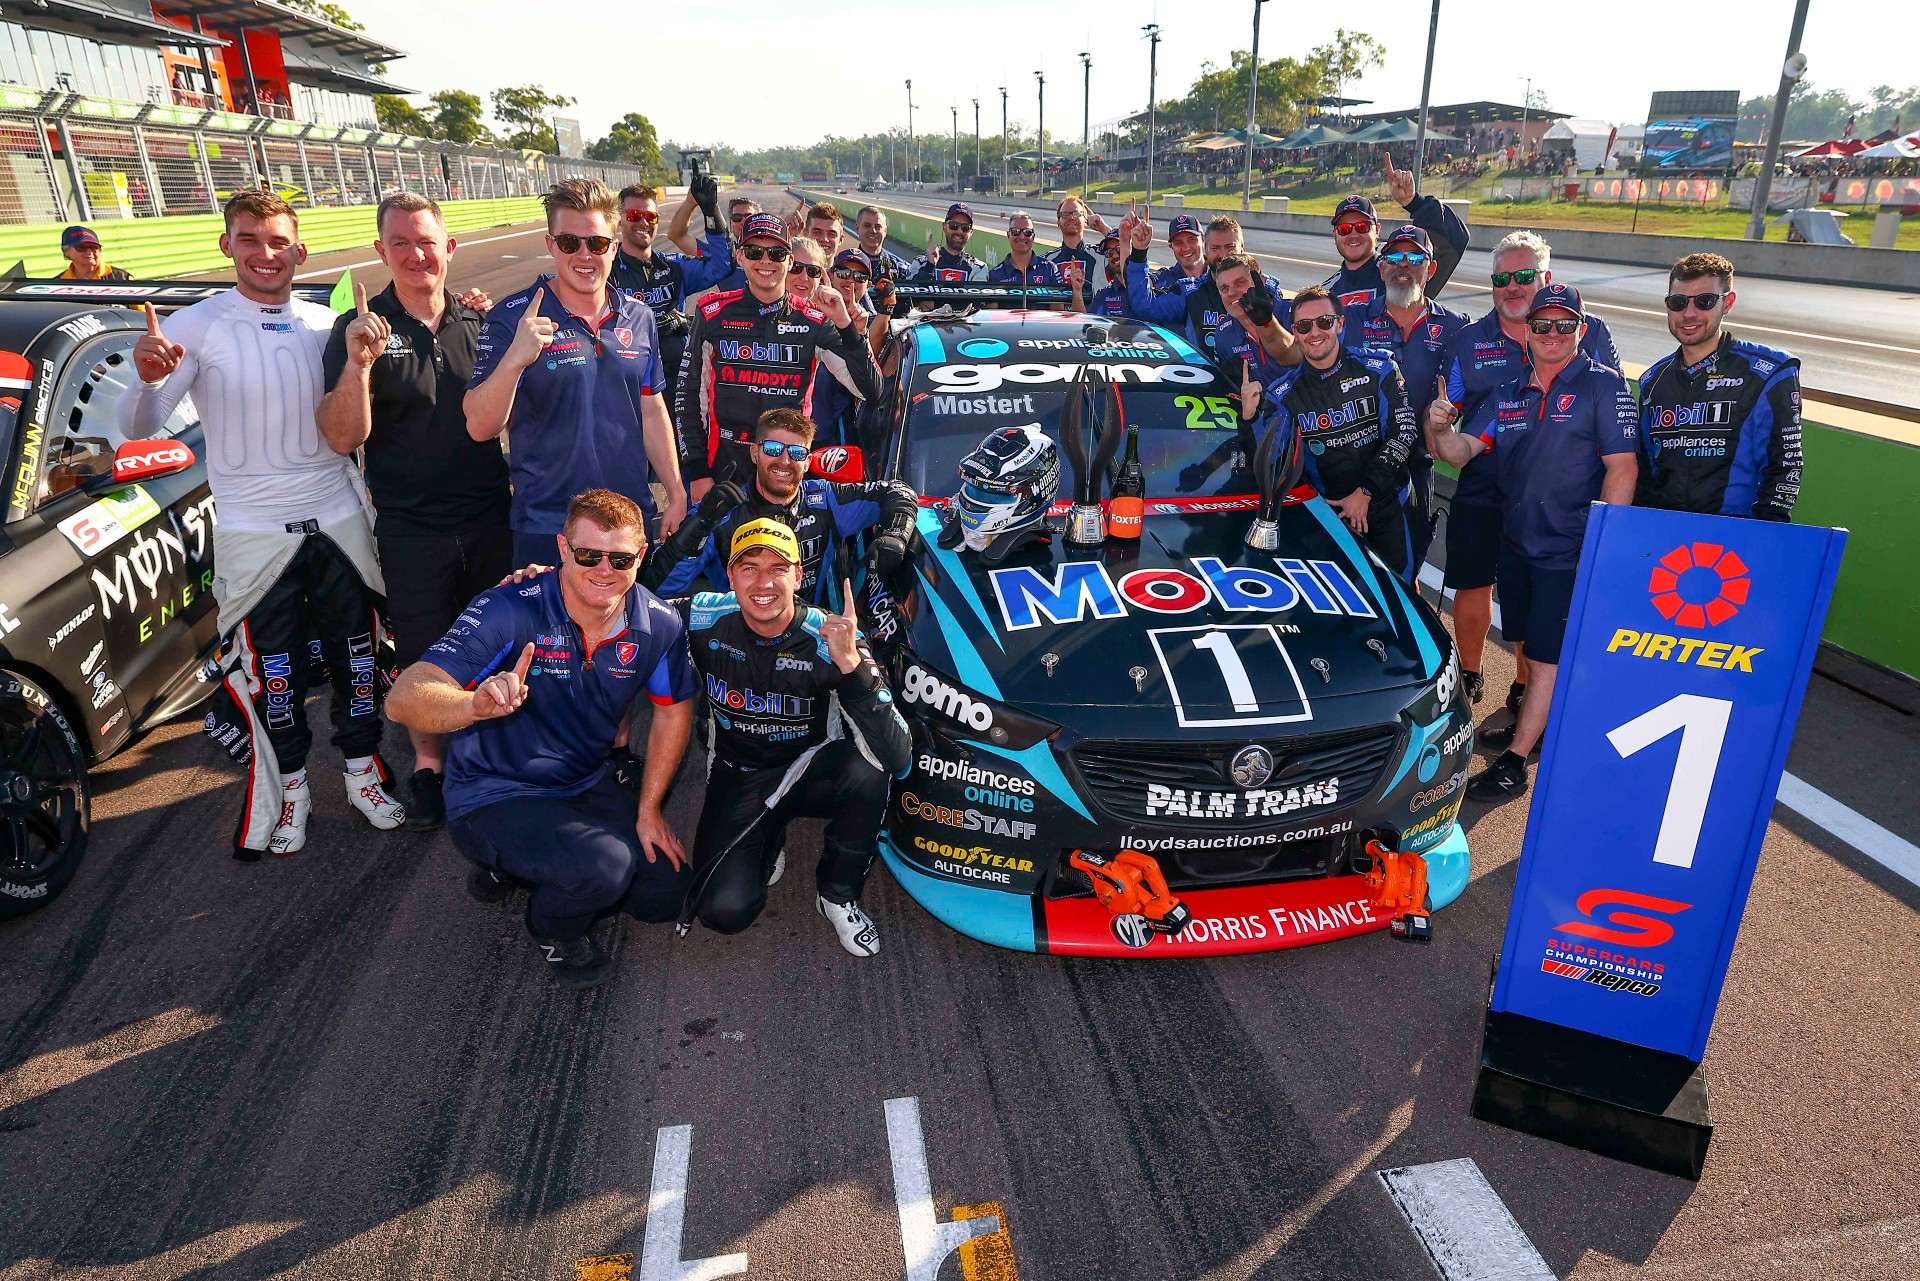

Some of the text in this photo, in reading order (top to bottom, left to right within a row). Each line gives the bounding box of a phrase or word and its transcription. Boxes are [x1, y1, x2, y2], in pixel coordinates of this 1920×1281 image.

[898, 285, 1008, 295] ppliances
[704, 302, 720, 315] OMP
[806, 309, 824, 318] OMP
[56, 313, 108, 342] TRADIE
[777, 324, 810, 335] gomo
[551, 341, 582, 352] MIDDY'S
[719, 339, 779, 361] Mobil
[1018, 338, 1164, 351] appliances
[1088, 346, 1170, 360] online
[1367, 359, 1383, 369] OMP
[1687, 359, 1711, 375] Mobil
[1754, 359, 1775, 374] OMP
[737, 370, 801, 387] MIDDY'S
[927, 363, 1215, 394] gomo
[1340, 375, 1371, 393] gomo
[1706, 378, 1744, 391] gomo
[34, 358, 55, 425] electrical
[748, 386, 798, 396] RACING
[1275, 381, 1291, 397] OMP
[933, 395, 1034, 416] Mostert
[1174, 395, 1239, 430] 25
[1650, 402, 1707, 427] Mobil
[1300, 401, 1356, 432] Mobil
[1326, 424, 1379, 447] appliances
[1354, 430, 1379, 448] online
[1663, 435, 1726, 450] appliances
[115, 447, 188, 472] RYCO
[820, 447, 848, 473] MF
[1013, 452, 1031, 467] Mobil
[1684, 446, 1726, 457] online
[808, 494, 823, 503] OMP
[1189, 500, 1247, 511] MORRIS
[1111, 514, 1142, 525] FOXTEL
[734, 527, 792, 543] DUNLOP
[987, 557, 1377, 632] Mobil
[649, 599, 671, 615] gomo
[56, 603, 95, 643] DUNLOP
[691, 613, 712, 625] OMP
[1277, 624, 1301, 634] TM
[536, 634, 563, 647] Mobil
[720, 642, 746, 658] appliances
[1606, 628, 1765, 673] PIRTEK
[775, 658, 814, 672] gomo
[262, 653, 293, 713] Mobil
[350, 656, 374, 717] Mobil
[706, 672, 782, 714] Mobil
[902, 665, 993, 730] gomo
[7, 681, 76, 744] DUNLOP
[733, 721, 809, 736] appliances
[768, 730, 810, 742] online
[919, 754, 1036, 796] appliances
[1605, 693, 1733, 869] 1
[965, 785, 1034, 813] online
[1146, 776, 1341, 818] PALM TRANS
[1119, 820, 1353, 852] lloydsauctions.com.au
[1411, 819, 1453, 850] AUTOCARE
[914, 836, 1034, 873] GOODYEAR
[934, 859, 1011, 884] AUTOCARE
[1115, 898, 1377, 947] MF MORRIS FINANCE
[1545, 949, 1663, 981] CHAMPIONSHIP
[1547, 938, 1665, 974] SUPERCARS
[1584, 968, 1661, 997] Repco
